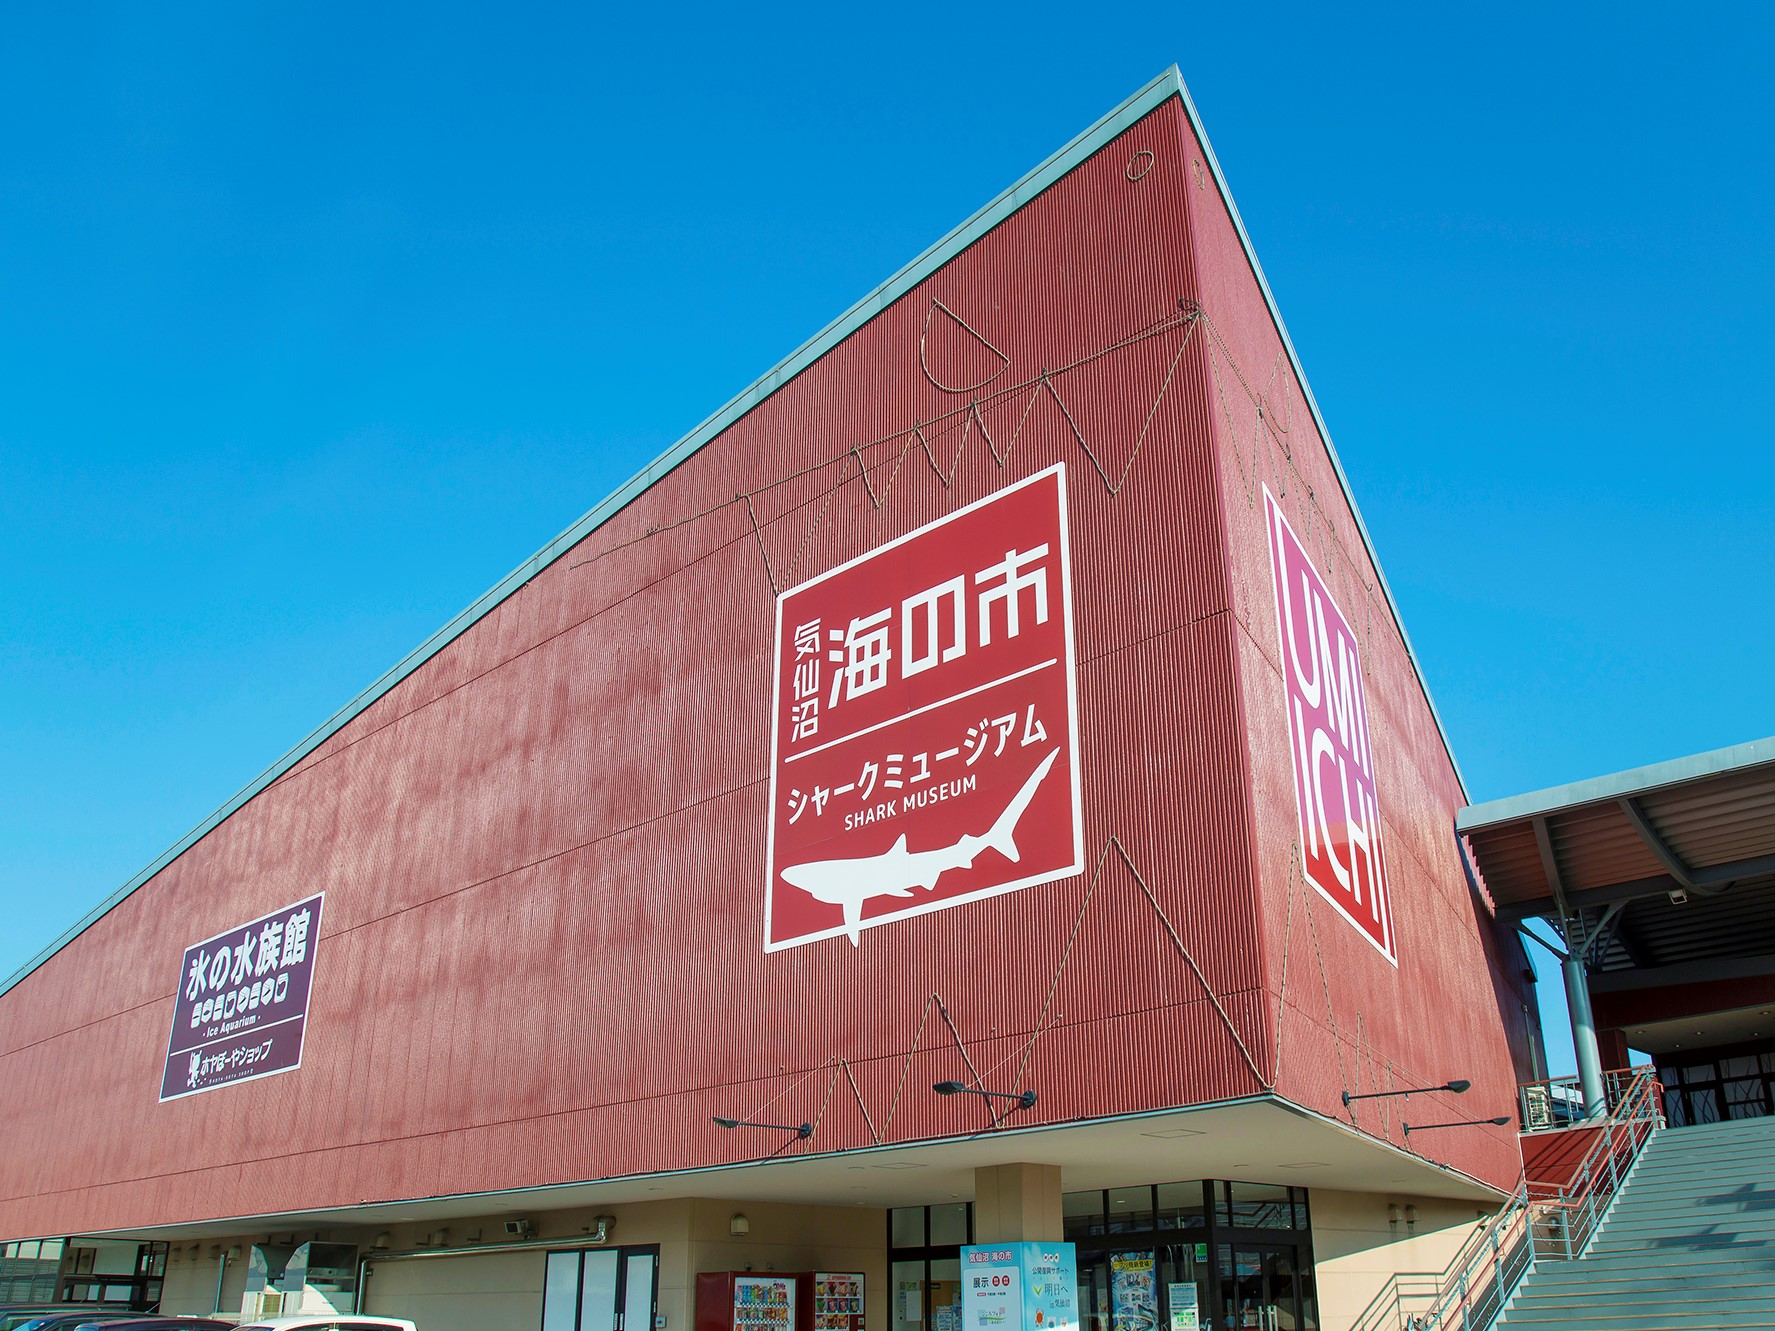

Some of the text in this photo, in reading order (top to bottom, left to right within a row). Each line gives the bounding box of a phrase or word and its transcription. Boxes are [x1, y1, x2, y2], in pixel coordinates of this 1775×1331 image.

[828, 543, 1048, 709] 海の市
[1272, 502, 1369, 780] UMI
[791, 617, 822, 743] 気仙沼
[786, 704, 1047, 825] シャークミュージアム
[844, 774, 977, 831] SHARK MUSEUM
[1293, 694, 1392, 961] ICHI
[185, 908, 311, 1001] 氷の水族館
[206, 1015, 256, 1038] Ice Aquarium
[973, 1276, 989, 1288] 展示
[1044, 1283, 1069, 1296] 明日へ
